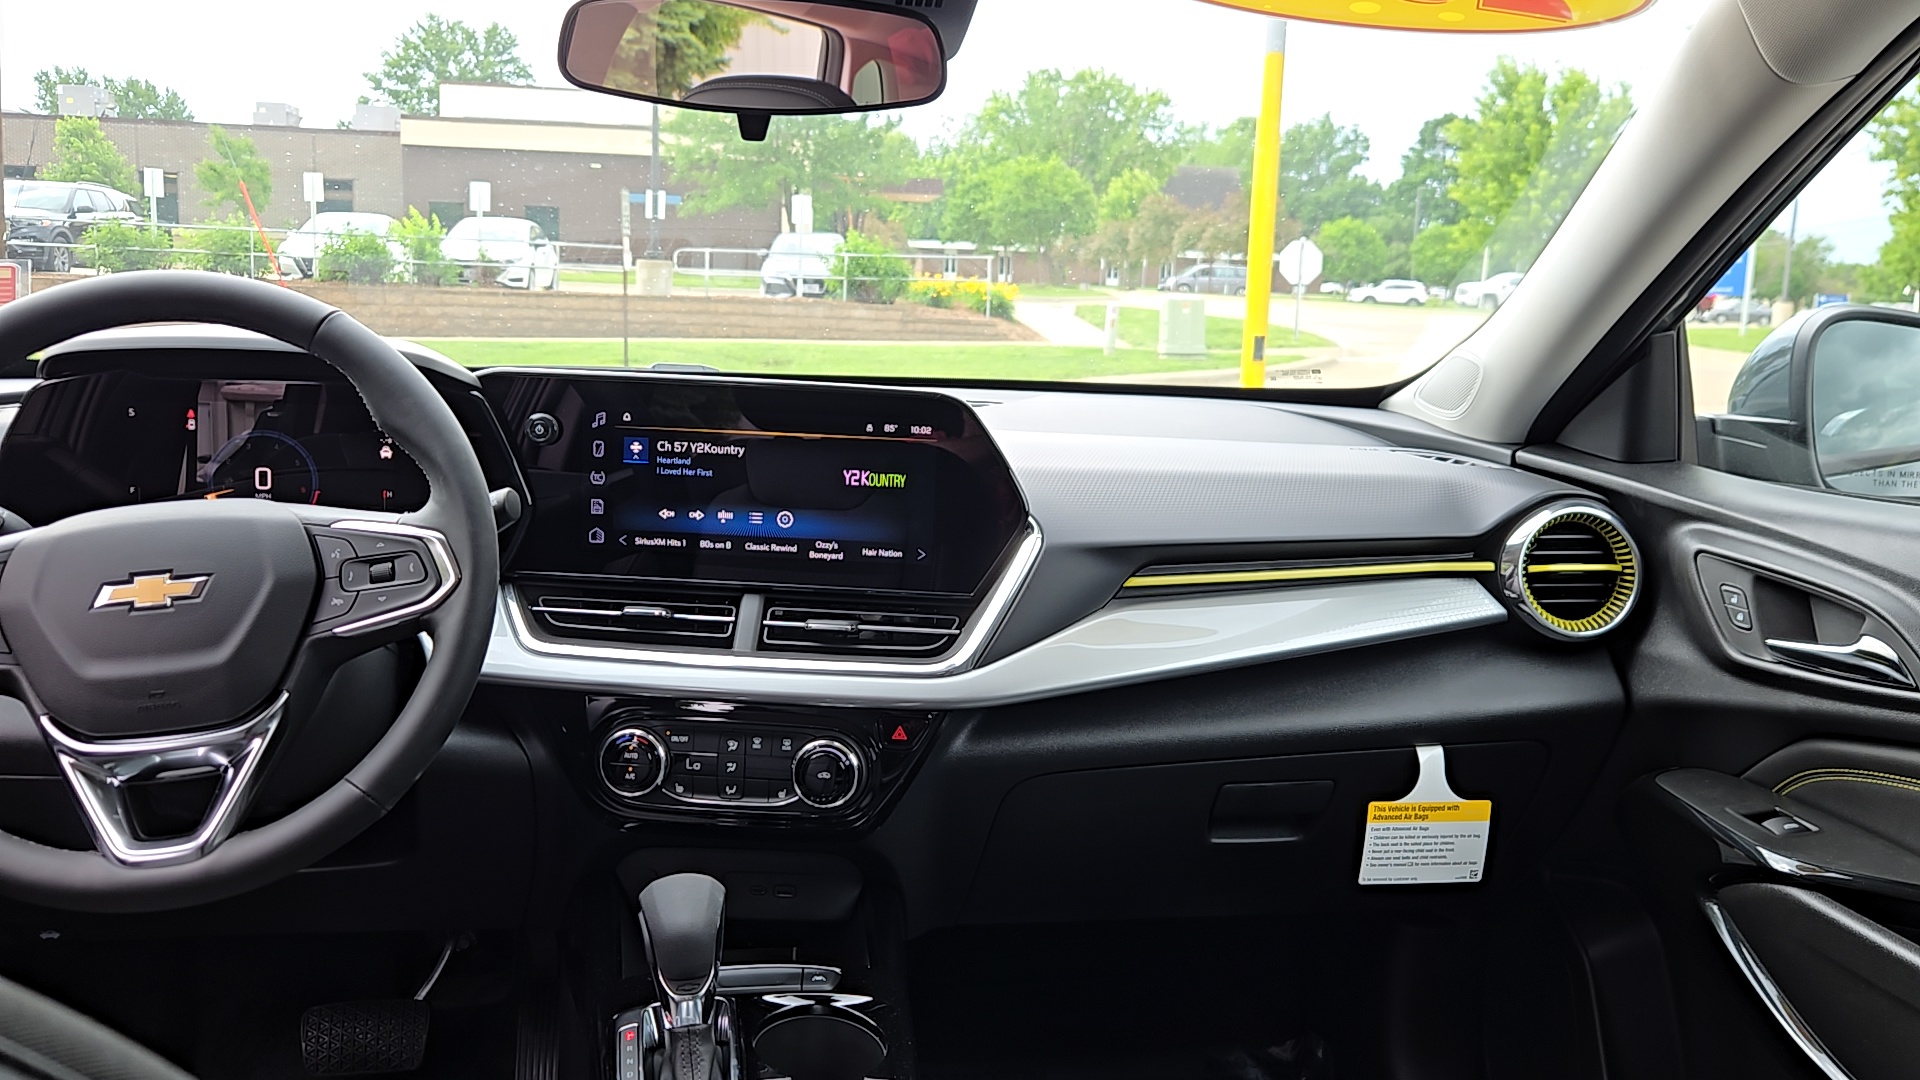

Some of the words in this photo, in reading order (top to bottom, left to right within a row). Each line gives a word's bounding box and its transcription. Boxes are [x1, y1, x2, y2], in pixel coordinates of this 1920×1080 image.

[910, 425, 932, 435] 10:02
[656, 440, 672, 452] Ch
[673, 441, 689, 453] 57
[689, 442, 746, 459] Y2Kountry
[656, 456, 692, 466] Heartland
[660, 467, 682, 476] Loved
[682, 468, 696, 477] Her
[696, 468, 713, 478] First
[1899, 471, 1920, 479] MIRR
[842, 469, 907, 489] Y2KOUNTRY
[1873, 479, 1898, 487] THAN
[1901, 480, 1920, 489] THE
[634, 536, 666, 547] SiriusXM
[666, 538, 682, 548] Hits
[715, 542, 724, 550] on
[815, 540, 839, 551] Ozzy's
[744, 542, 770, 552] Classic
[770, 543, 798, 554] Rewind
[861, 547, 877, 557] Hair
[878, 548, 903, 558] Nation
[808, 550, 844, 562] Boneyard
[623, 752, 639, 760] AUTO
[685, 757, 701, 771] Lo
[624, 772, 636, 781] A/C
[1373, 805, 1387, 813] This
[1387, 804, 1410, 813] Vehicle
[1411, 804, 1417, 812] is
[1417, 804, 1446, 813] Equipped
[1446, 803, 1460, 812] with
[1372, 813, 1403, 821] Advanced
[1413, 812, 1429, 822] Bags
[626, 1058, 634, 1066] N
[626, 1071, 634, 1079] D
